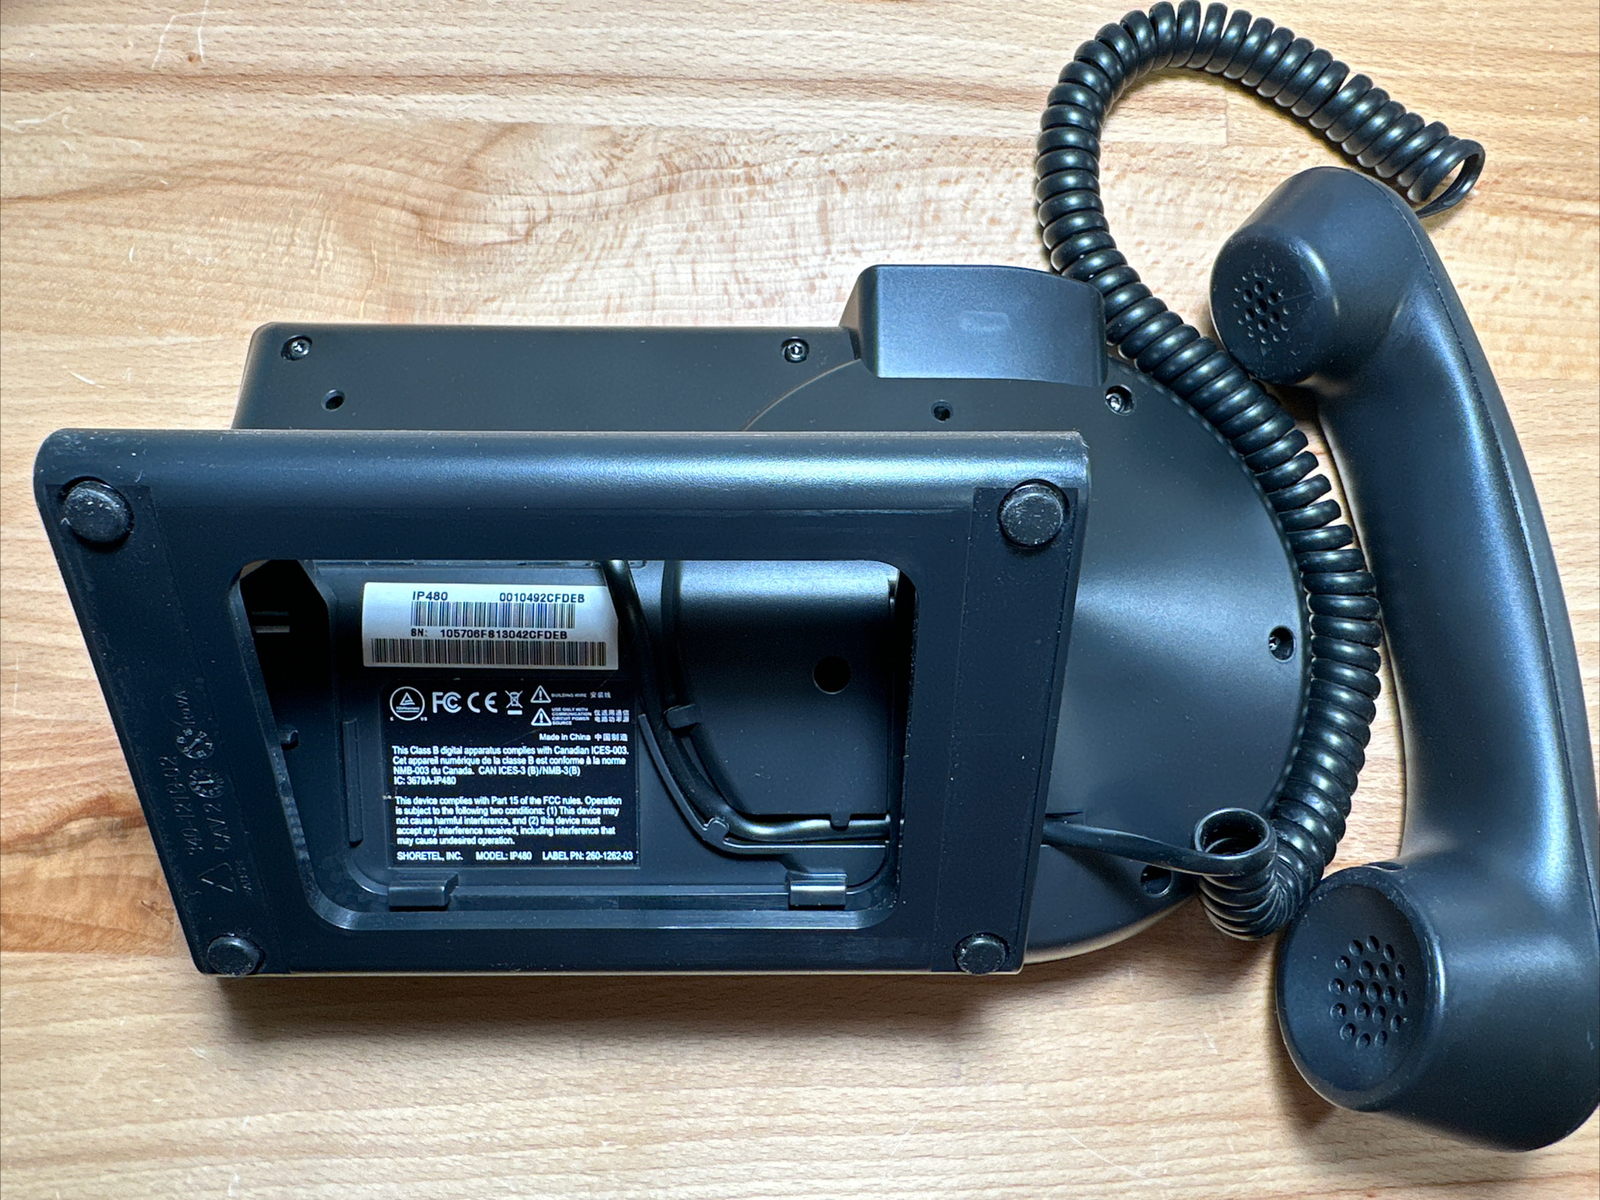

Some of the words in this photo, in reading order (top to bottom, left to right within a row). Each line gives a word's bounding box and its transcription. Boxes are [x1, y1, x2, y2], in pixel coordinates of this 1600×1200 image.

[412, 591, 448, 601] IP480
[499, 592, 585, 603] 0010492CFDEB
[467, 691, 498, 713] CE
[539, 733, 560, 741] Made
[561, 733, 568, 741] in
[569, 733, 591, 741] China
[391, 746, 409, 754] This
[410, 746, 431, 754] Class
[432, 746, 440, 754] B
[440, 746, 463, 757] digital
[464, 746, 502, 757] apparatus
[502, 746, 536, 756] complies
[537, 746, 552, 754] with
[553, 746, 589, 754] Canadian
[591, 746, 629, 754] ICES-003.
[392, 756, 407, 765] Cet
[408, 756, 438, 766] appareil
[440, 756, 480, 766] numérique
[481, 756, 492, 765] de
[493, 756, 501, 765] la
[502, 756, 526, 765] classe
[527, 756, 535, 765] B
[536, 756, 548, 765] est
[549, 756, 584, 765] conforme
[586, 756, 591, 765] à
[592, 756, 600, 765] la
[393, 766, 430, 775] NMB-003
[430, 766, 441, 775] du
[442, 766, 475, 775] Canada.
[478, 766, 497, 775] CAN
[498, 766, 526, 775] ICES-3
[527, 766, 581, 776] (B)/NMB-3(B)
[393, 776, 406, 785] IC:
[406, 776, 457, 785] 3678A-IP480
[395, 796, 412, 805] This
[413, 796, 438, 805] device
[439, 796, 473, 806] complies
[474, 796, 490, 805] with
[491, 796, 508, 805] Part
[509, 796, 518, 805] 15
[520, 796, 528, 805] of
[529, 796, 542, 805] the
[543, 796, 561, 805] FCC
[562, 796, 583, 805] rules.
[584, 795, 622, 806] Operation
[395, 806, 402, 815] is
[404, 806, 431, 817] subject
[432, 806, 440, 815] to
[441, 806, 454, 815] the
[455, 806, 488, 817] following
[490, 806, 503, 815] two
[505, 806, 545, 815] conditions:
[546, 806, 557, 816] (1)
[558, 806, 575, 815] This
[576, 806, 601, 815] device
[602, 807, 620, 817] may
[396, 816, 409, 825] not
[434, 816, 463, 825] harmful
[464, 816, 511, 825] interference,
[511, 816, 527, 825] and
[528, 816, 539, 826] (2)
[540, 816, 554, 825] this
[555, 816, 580, 825] device
[581, 817, 601, 825] must
[396, 827, 422, 836] accept
[423, 828, 438, 837] any
[438, 826, 483, 835] interference
[484, 826, 519, 835] received,
[520, 826, 554, 837] including
[554, 826, 599, 835] interference
[600, 826, 616, 835] that
[396, 837, 414, 846] may
[415, 837, 438, 845] cause
[439, 836, 476, 845] undesired
[477, 836, 515, 846] operation.
[396, 851, 445, 861] SHORETEL,
[446, 851, 463, 860] INC.
[475, 851, 508, 860] MODEL:
[509, 851, 532, 860] IP480
[542, 851, 569, 860] LABEL
[570, 851, 584, 860] PN:
[585, 851, 633, 860] 260-1262-03
